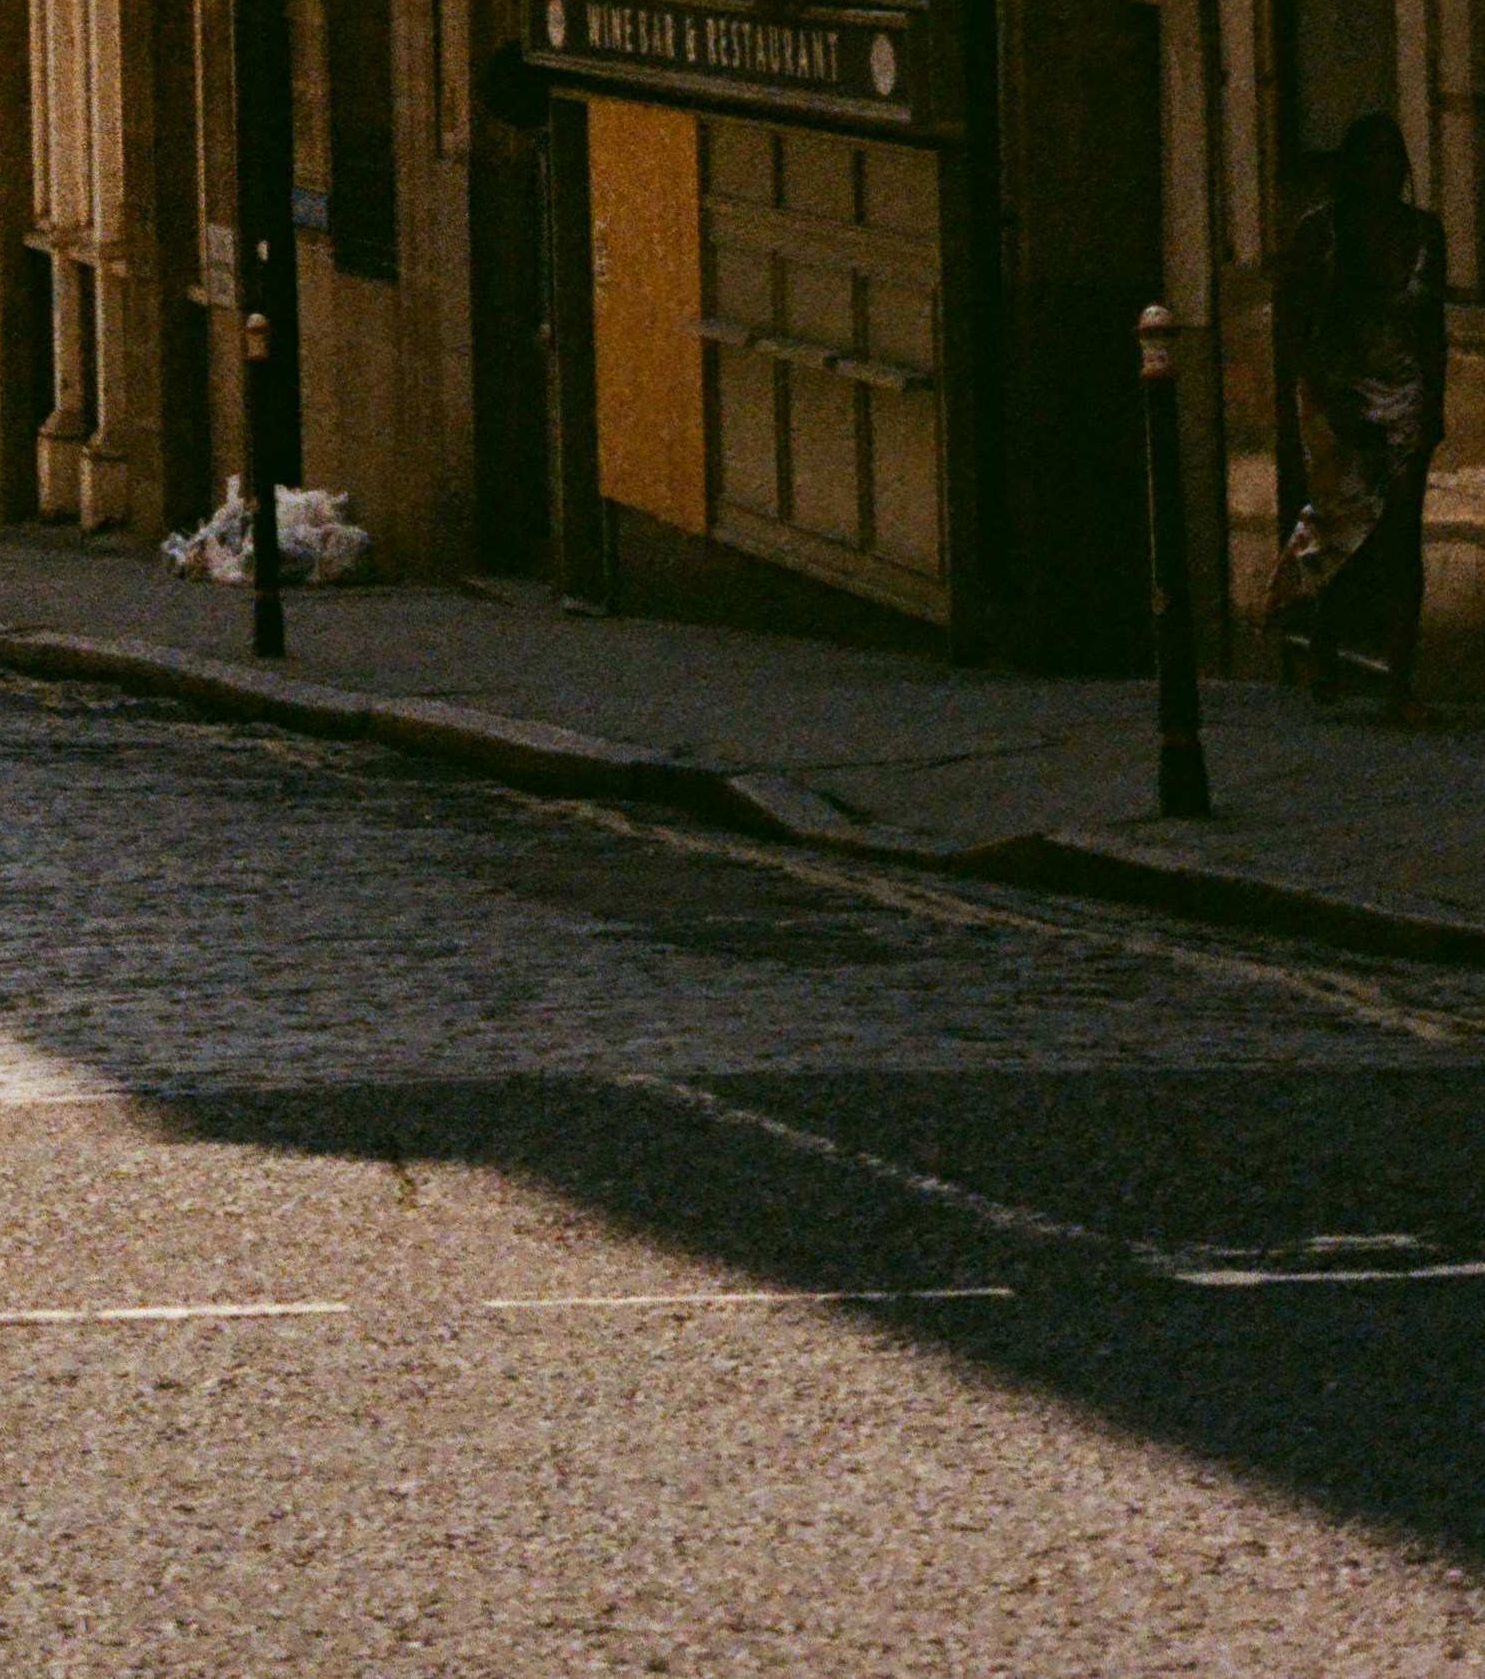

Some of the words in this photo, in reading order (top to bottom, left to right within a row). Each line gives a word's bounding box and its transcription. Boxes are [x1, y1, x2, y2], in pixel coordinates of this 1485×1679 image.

[586, 3, 632, 52] WINE
[637, 9, 676, 59] BAR
[705, 17, 838, 82] RESTAURANT
